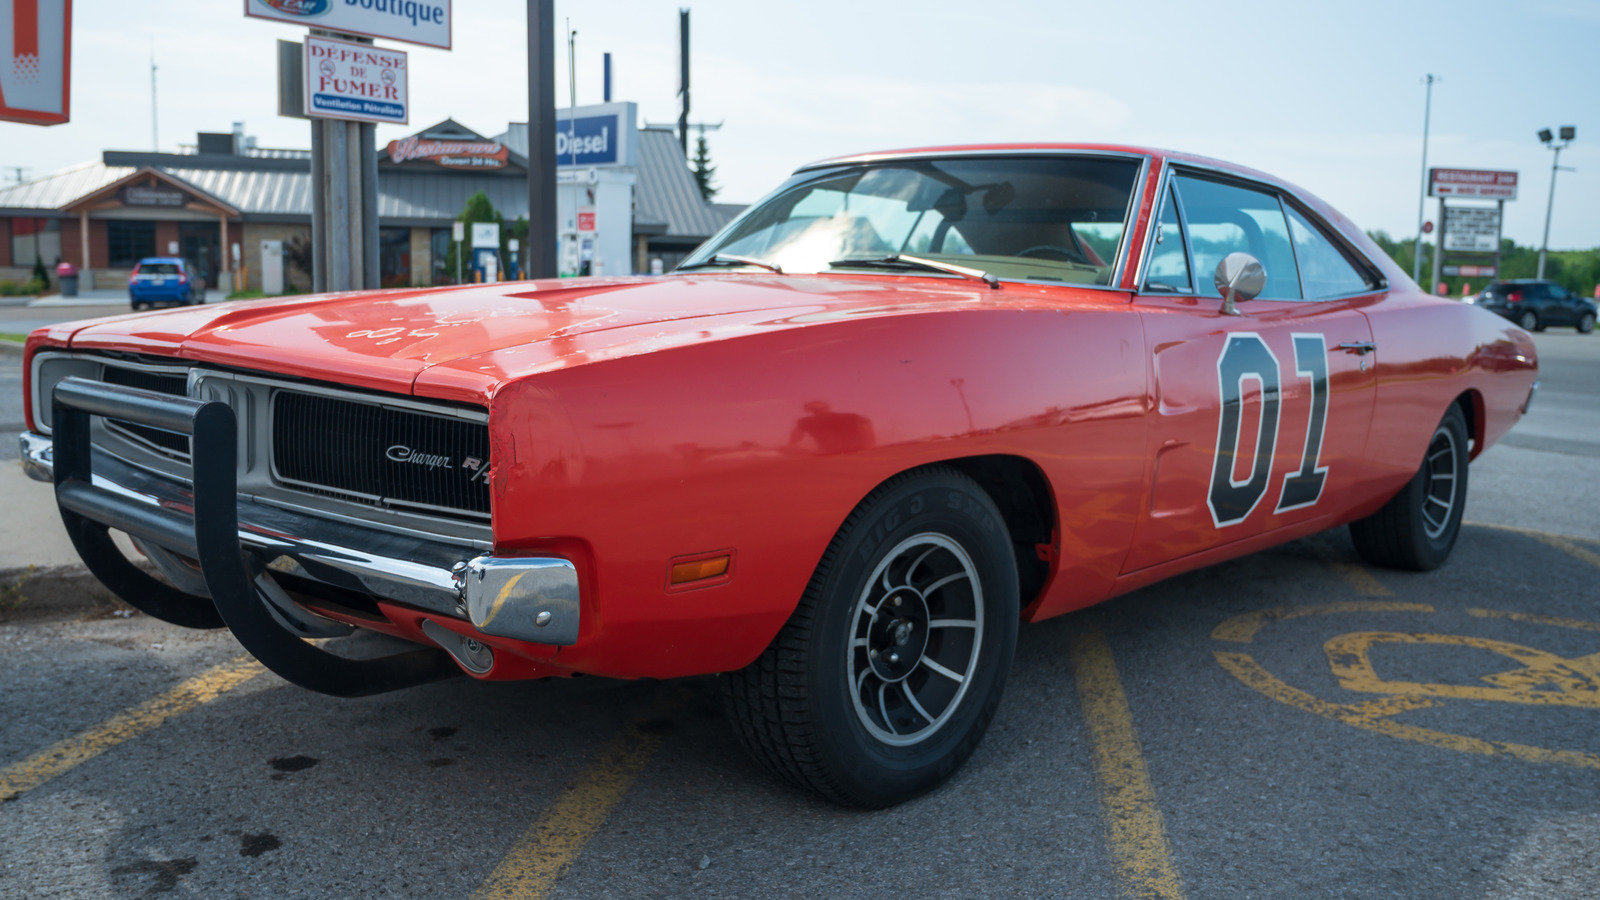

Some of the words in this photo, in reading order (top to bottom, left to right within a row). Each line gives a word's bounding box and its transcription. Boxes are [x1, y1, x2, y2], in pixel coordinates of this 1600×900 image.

[344, 0, 444, 26] outique
[311, 45, 405, 69] DÉFENSE
[350, 66, 367, 79] DE
[319, 76, 399, 100] FUMER
[315, 96, 362, 110] Ventilation
[556, 126, 608, 155] Diesel
[1207, 332, 1330, 528] 01
[386, 445, 452, 471] Charger
